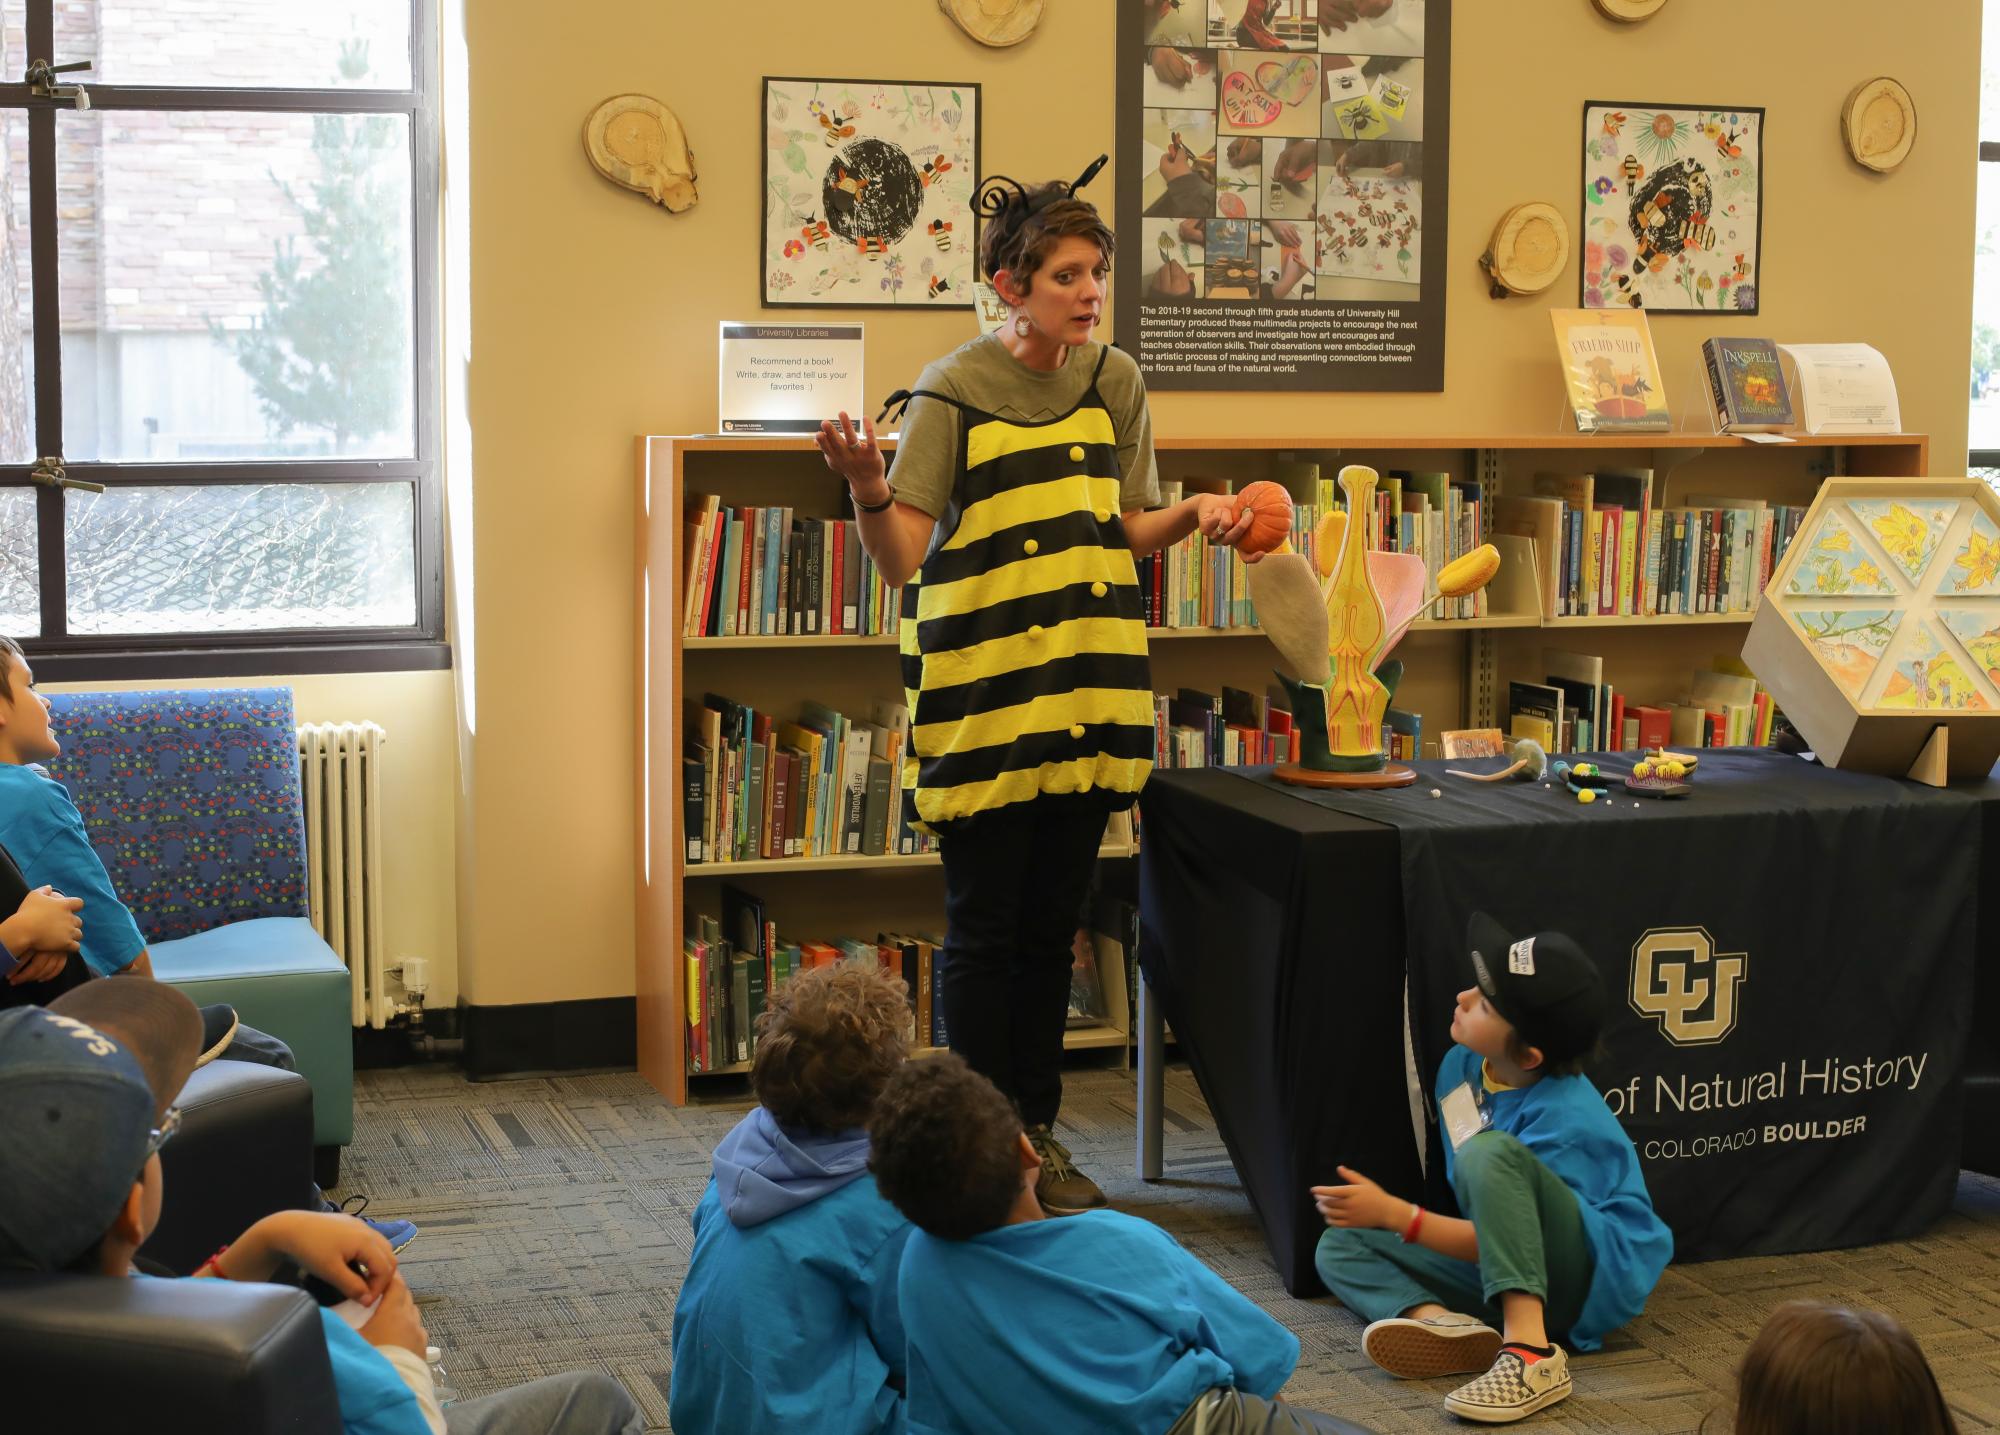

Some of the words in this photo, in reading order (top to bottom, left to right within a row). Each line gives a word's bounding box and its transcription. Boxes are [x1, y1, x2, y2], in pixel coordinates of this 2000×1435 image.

[1140, 306, 1156, 314] The
[1158, 306, 1191, 315] 2018-19
[1193, 307, 1223, 315] second
[1225, 307, 1256, 317] through
[1258, 307, 1274, 316] fifth
[1276, 308, 1298, 318] grade
[1300, 308, 1335, 317] students
[1336, 308, 1345, 317] of
[1346, 309, 1386, 319] University
[1387, 309, 1400, 317] Hill
[1140, 317, 1186, 328] Elementary
[1188, 318, 1227, 328] produced
[1229, 318, 1252, 327] these
[1253, 319, 1297, 327] multimedia
[1299, 320, 1331, 330] projects
[1333, 320, 1341, 328] to
[1342, 322, 1384, 330] encourage
[757, 328, 794, 338] University
[796, 328, 829, 336] Libraries
[1140, 329, 1184, 340] generation
[1186, 329, 1194, 338] of
[1196, 330, 1236, 338] observers
[1238, 330, 1254, 338] and
[1256, 330, 1298, 340] investigate
[1300, 330, 1317, 339] how
[1332, 333, 1378, 341] encourages
[1380, 332, 1394, 340] and
[1140, 341, 1173, 349] teaches
[1174, 341, 1222, 349] observation
[1224, 341, 1246, 349] skills.
[1248, 341, 1269, 350] Their
[1270, 342, 1322, 350] observations
[1344, 342, 1384, 351] embodied
[1386, 343, 1416, 352] through
[1572, 339, 1612, 354] FRIEND
[1616, 340, 1640, 354] SHIP
[750, 357, 802, 365] Recommend
[811, 357, 834, 365] book!
[1140, 352, 1154, 360] the
[1156, 352, 1183, 361] artistic
[1185, 354, 1218, 362] process
[1219, 352, 1228, 361] of
[1230, 352, 1259, 363] making
[1260, 353, 1276, 361] and
[1278, 353, 1328, 363] representing
[1329, 353, 1377, 362] connections
[1379, 354, 1412, 362] between
[1723, 348, 1776, 363] INKSPELL
[1140, 363, 1154, 372] the
[1156, 363, 1174, 372] flora
[1176, 364, 1192, 372] and
[1194, 363, 1216, 372] fauna
[1218, 364, 1226, 372] of
[1228, 364, 1242, 372] the
[1243, 364, 1271, 372] natural
[1272, 364, 1297, 373] world.
[736, 371, 758, 379] Write,
[762, 371, 784, 380] draw,
[850, 772, 863, 823] AFTERWORLDS
[1628, 926, 1748, 1046] CU
[1604, 1077, 1640, 1116] of
[1655, 1062, 1786, 1114] Natural
[1800, 1052, 1928, 1096] History
[1644, 1128, 1756, 1159] COLORADO
[1763, 1116, 1866, 1143] BOULDER
